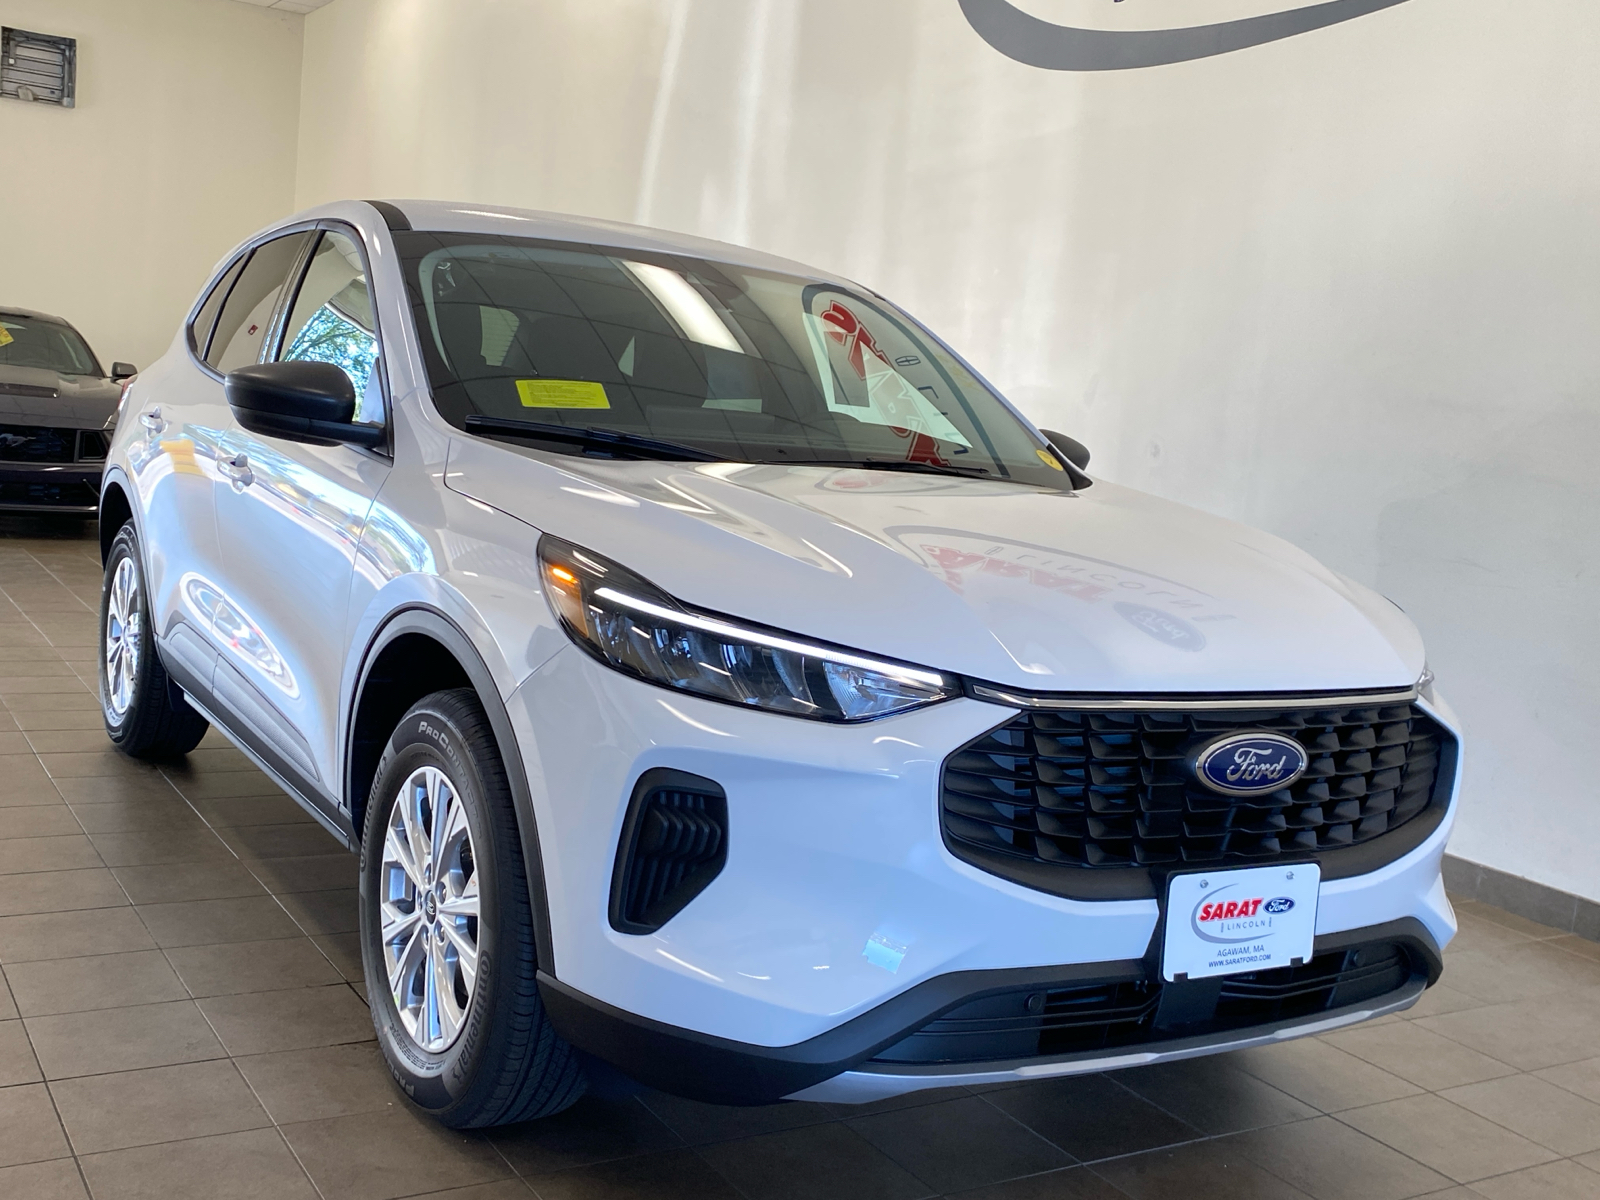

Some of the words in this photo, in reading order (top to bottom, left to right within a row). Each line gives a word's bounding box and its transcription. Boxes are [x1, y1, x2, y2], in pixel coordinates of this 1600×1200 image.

[1226, 747, 1287, 781] Ford
[1198, 897, 1264, 922] SARAT
[1267, 899, 1291, 913] Ford
[1227, 920, 1266, 931] LINCOLN
[1217, 946, 1252, 958] AGAWAM,
[1253, 944, 1265, 953] MA
[1208, 953, 1272, 968] WWW.SARATFORD.COM
